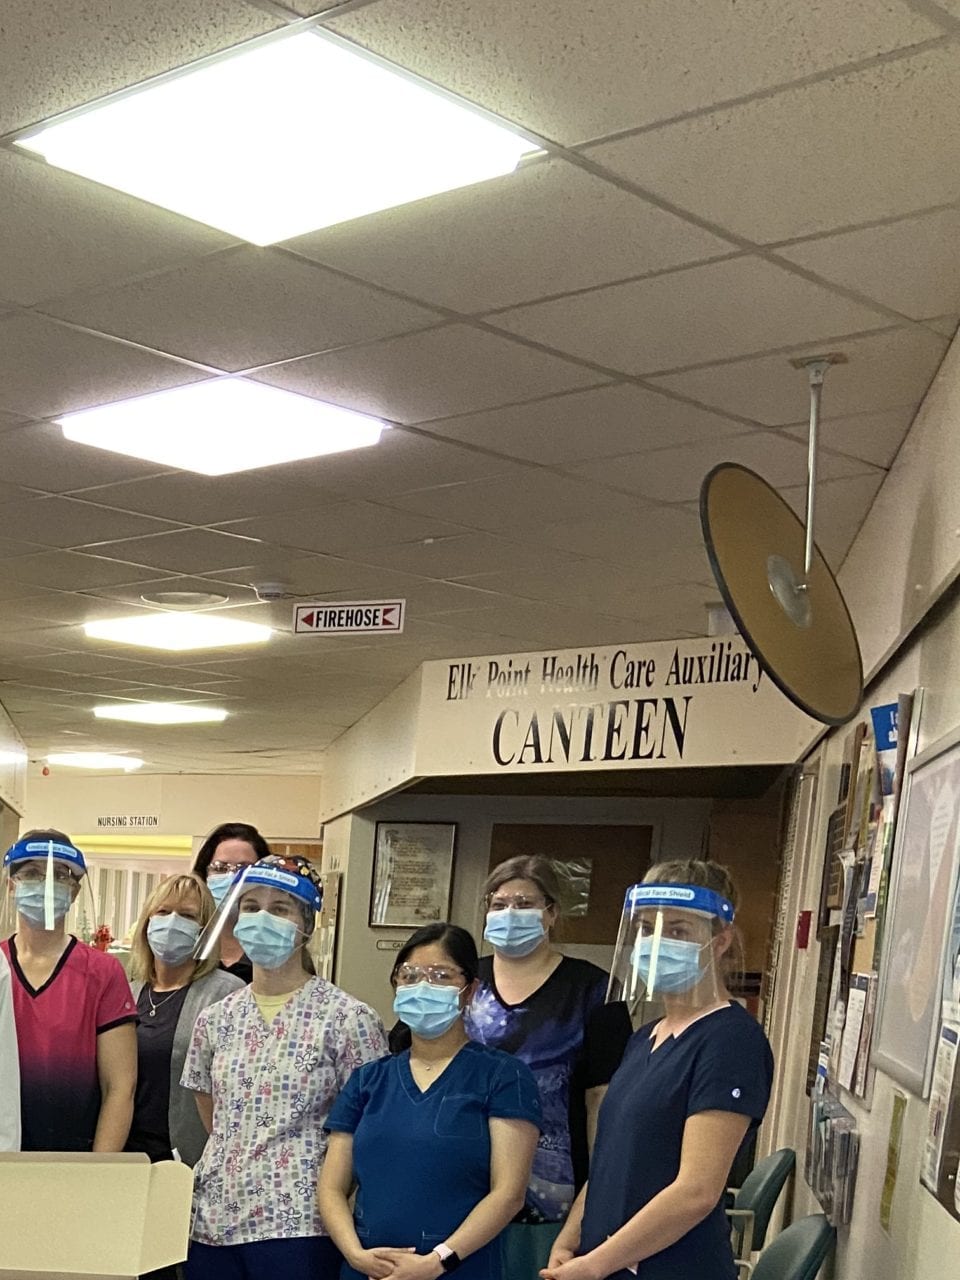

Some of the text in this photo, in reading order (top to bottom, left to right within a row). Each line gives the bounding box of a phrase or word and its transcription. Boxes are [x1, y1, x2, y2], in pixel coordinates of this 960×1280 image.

[316, 608, 380, 628] FIREHOSE
[447, 641, 763, 700] Elk Point Health Care Auxiliary
[492, 696, 693, 766] CANTEEN
[97, 816, 158, 827] NURSING STATION
